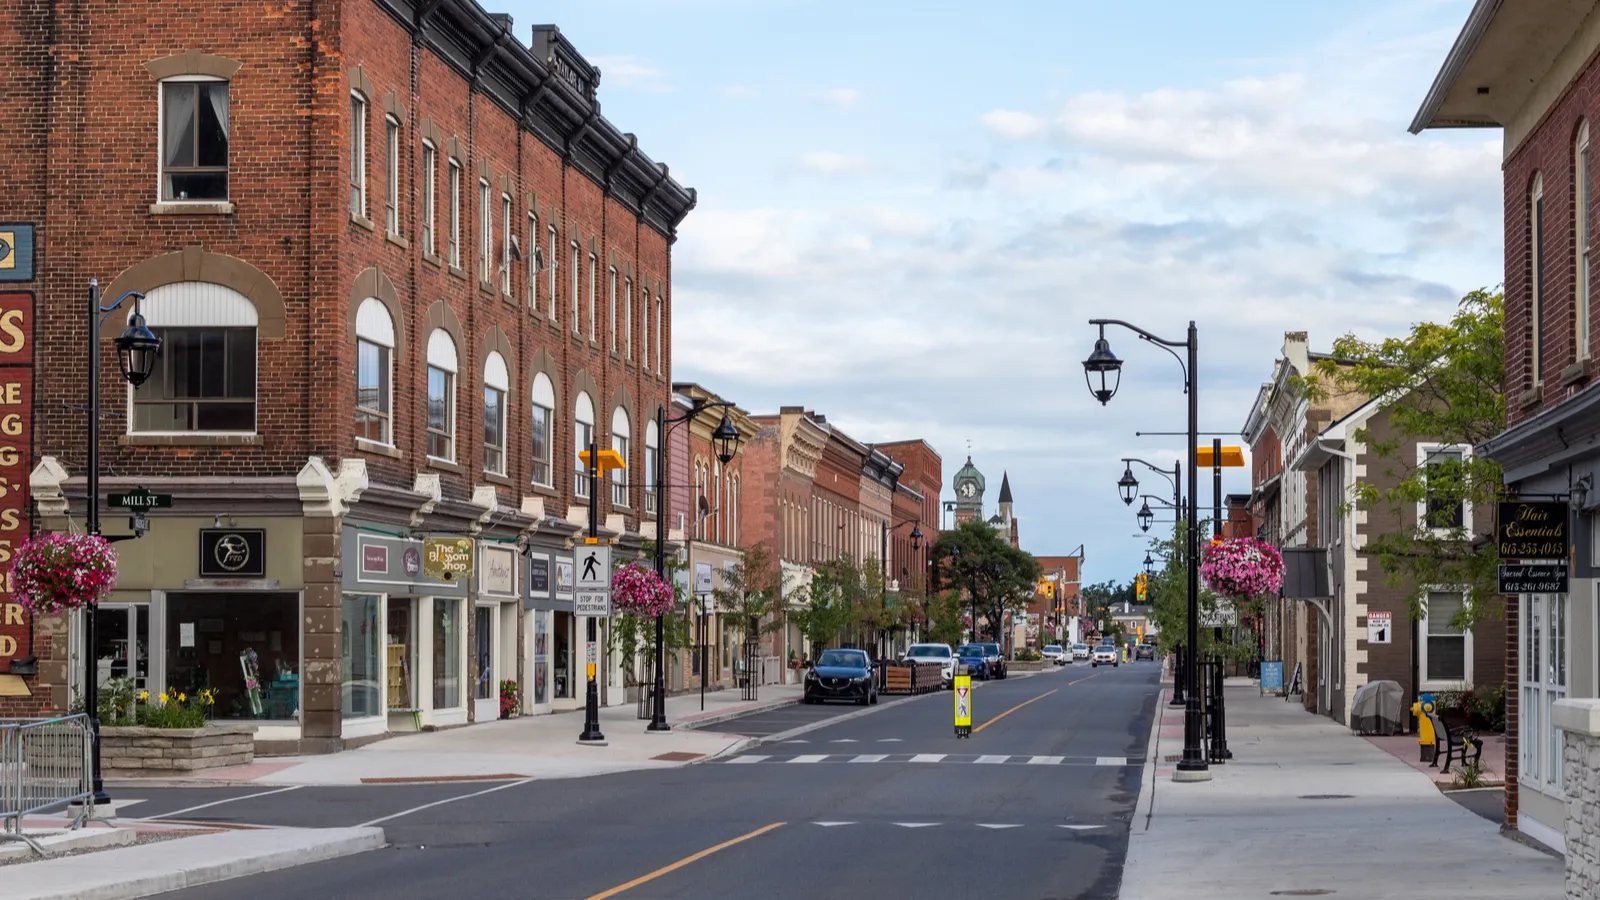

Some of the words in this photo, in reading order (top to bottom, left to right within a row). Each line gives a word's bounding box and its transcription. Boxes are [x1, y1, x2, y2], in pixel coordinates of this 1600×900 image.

[122, 495, 145, 506] MILL
[146, 495, 159, 506] ST.
[1516, 504, 1549, 521] Hair
[1505, 521, 1564, 538] Essentials
[434, 544, 454, 554] The
[429, 551, 469, 562] Blossom
[442, 561, 467, 572] Shop
[1527, 567, 1551, 578] Essence
[1505, 582, 1561, 591] 613-261-9687
[577, 604, 607, 612] PEDESTRIANS
